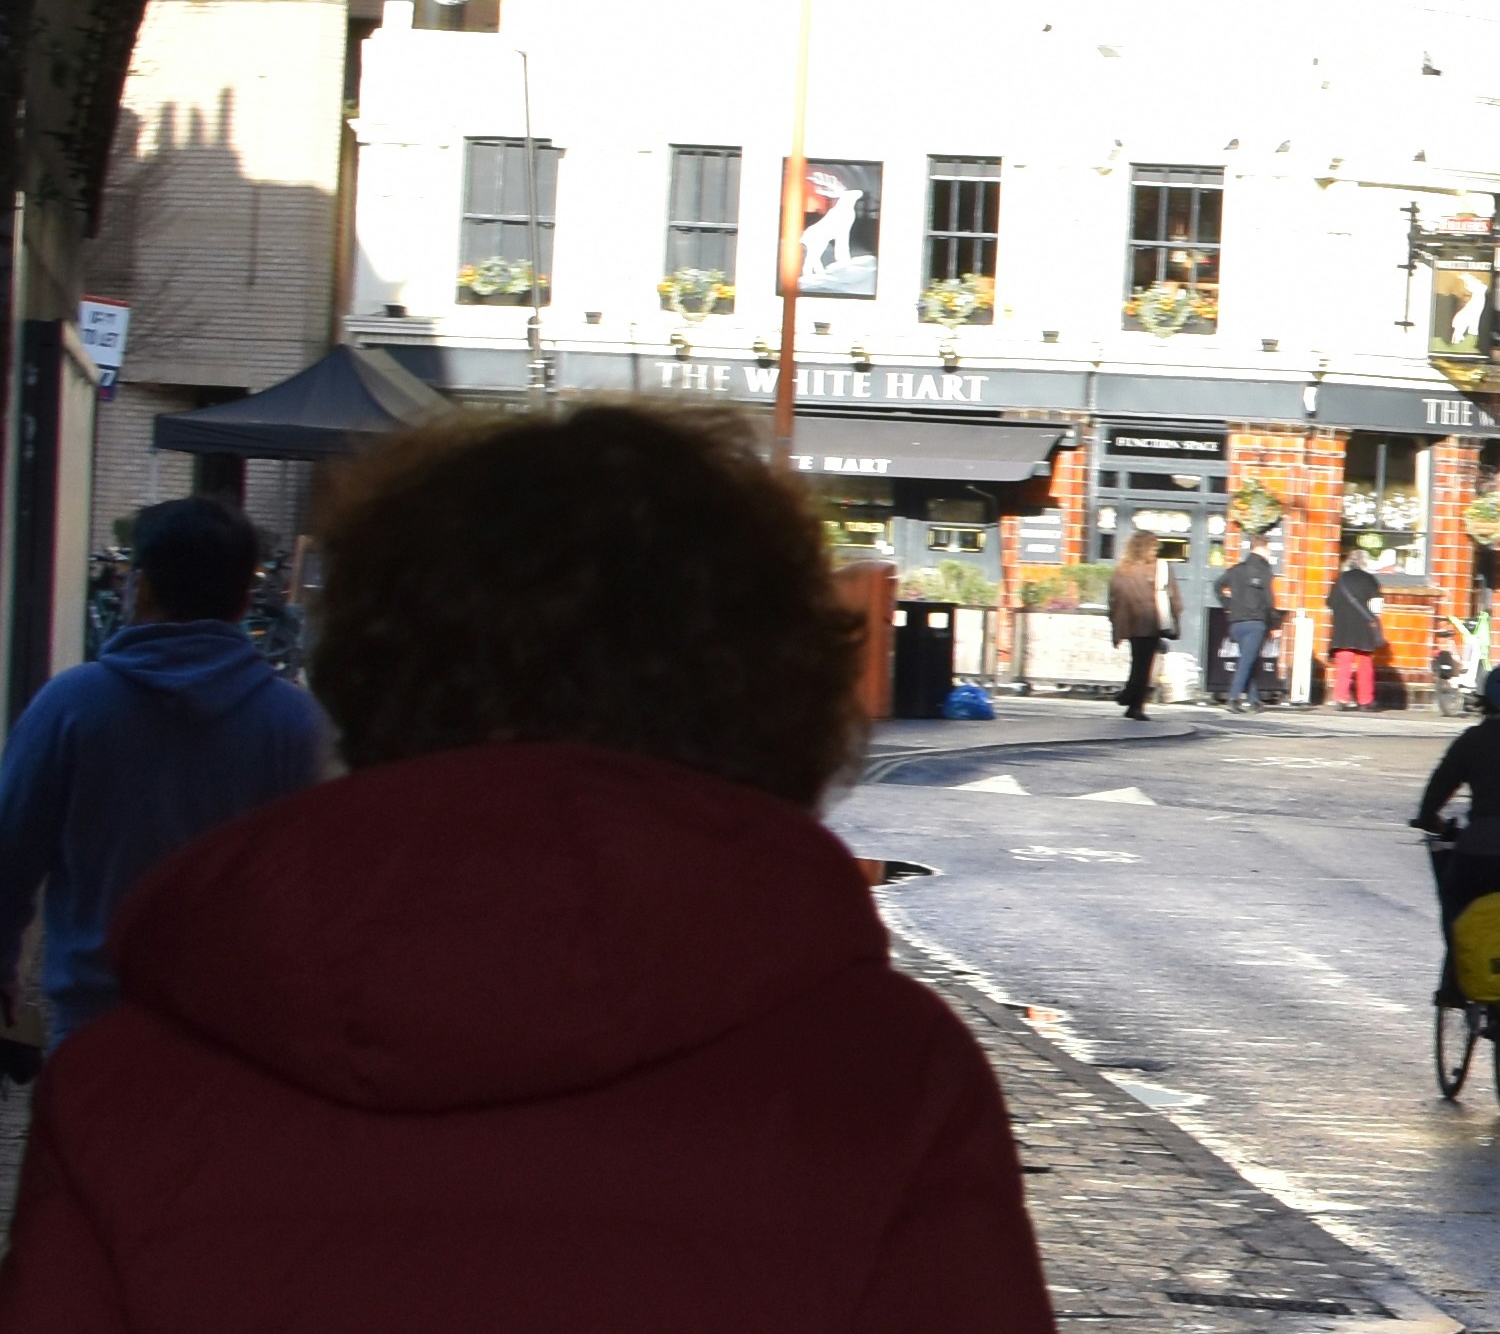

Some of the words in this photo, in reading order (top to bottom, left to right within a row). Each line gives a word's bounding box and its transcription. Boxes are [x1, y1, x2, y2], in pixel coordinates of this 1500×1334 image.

[656, 362, 731, 392] THE
[886, 372, 990, 402] HART
[1422, 398, 1473, 426] THE
[824, 457, 891, 473] HART
